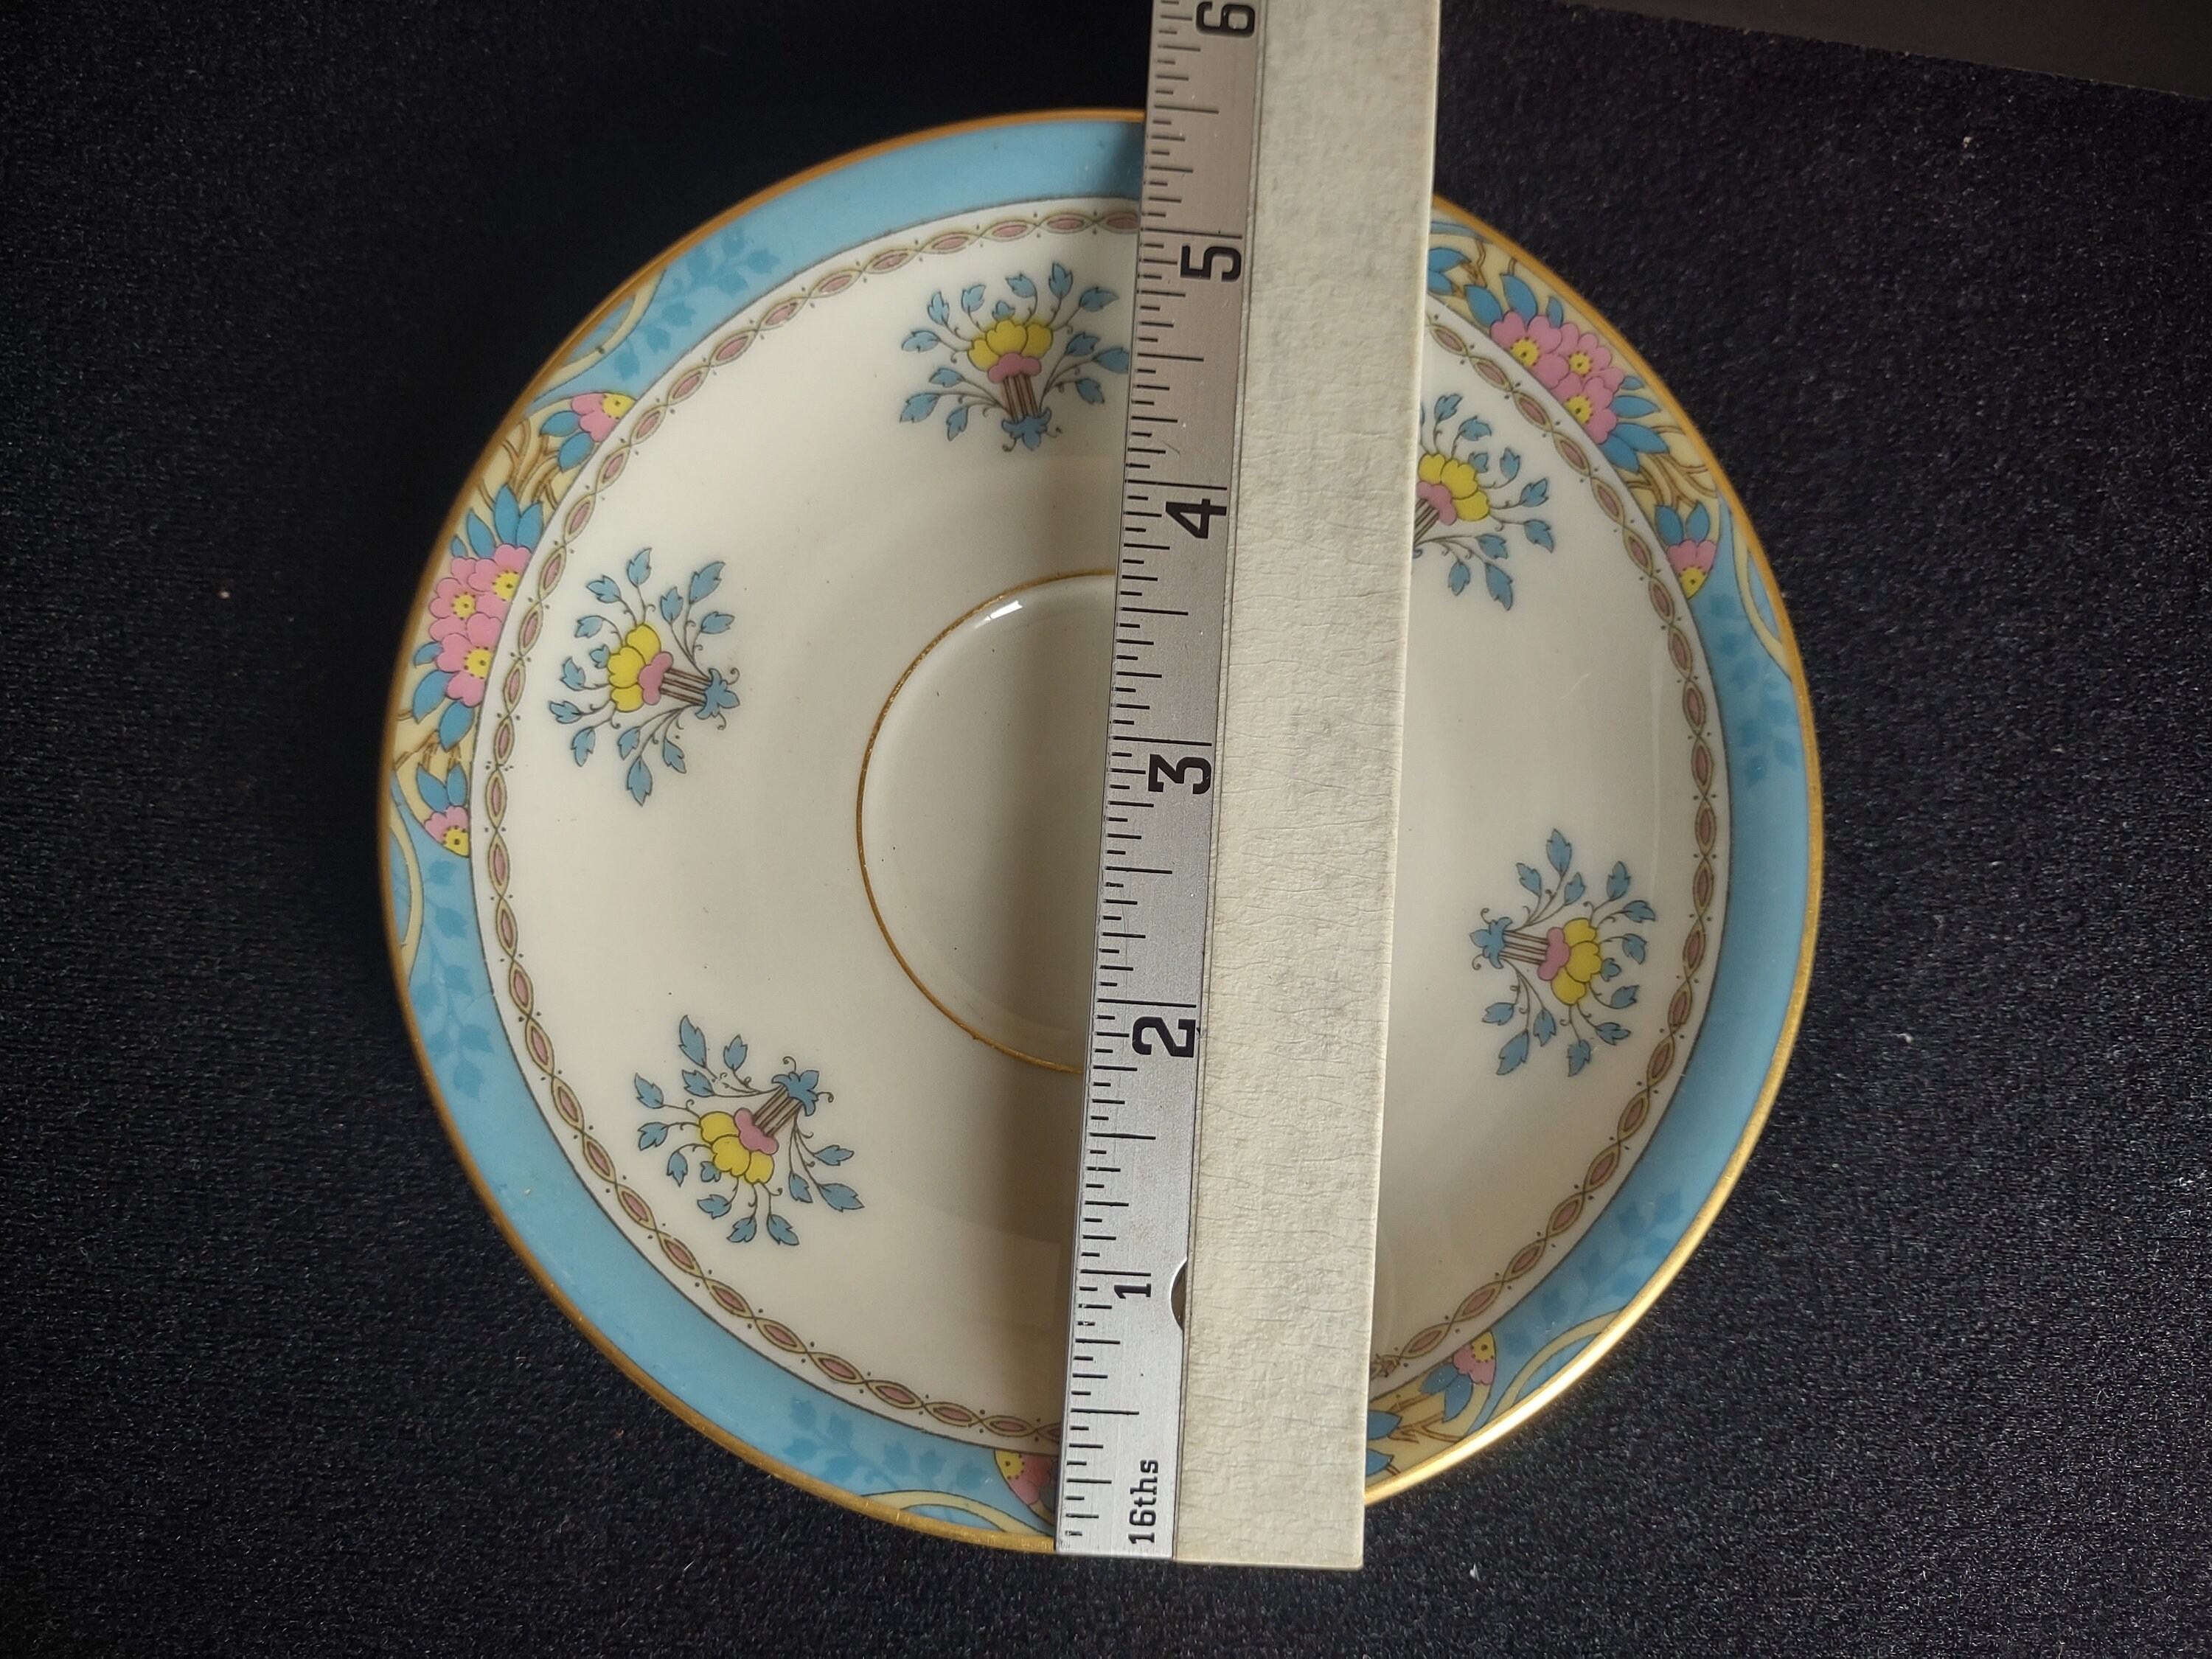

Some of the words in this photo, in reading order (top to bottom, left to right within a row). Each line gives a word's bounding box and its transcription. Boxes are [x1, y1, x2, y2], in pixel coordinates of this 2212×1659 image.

[1196, 0, 1255, 37] 6
[1180, 244, 1242, 282] 5
[1165, 498, 1227, 539] 4
[1148, 754, 1212, 795] 3
[1131, 1016, 1196, 1059] 2
[1113, 1282, 1152, 1300] 1
[1127, 1458, 1159, 1545] 16ths
